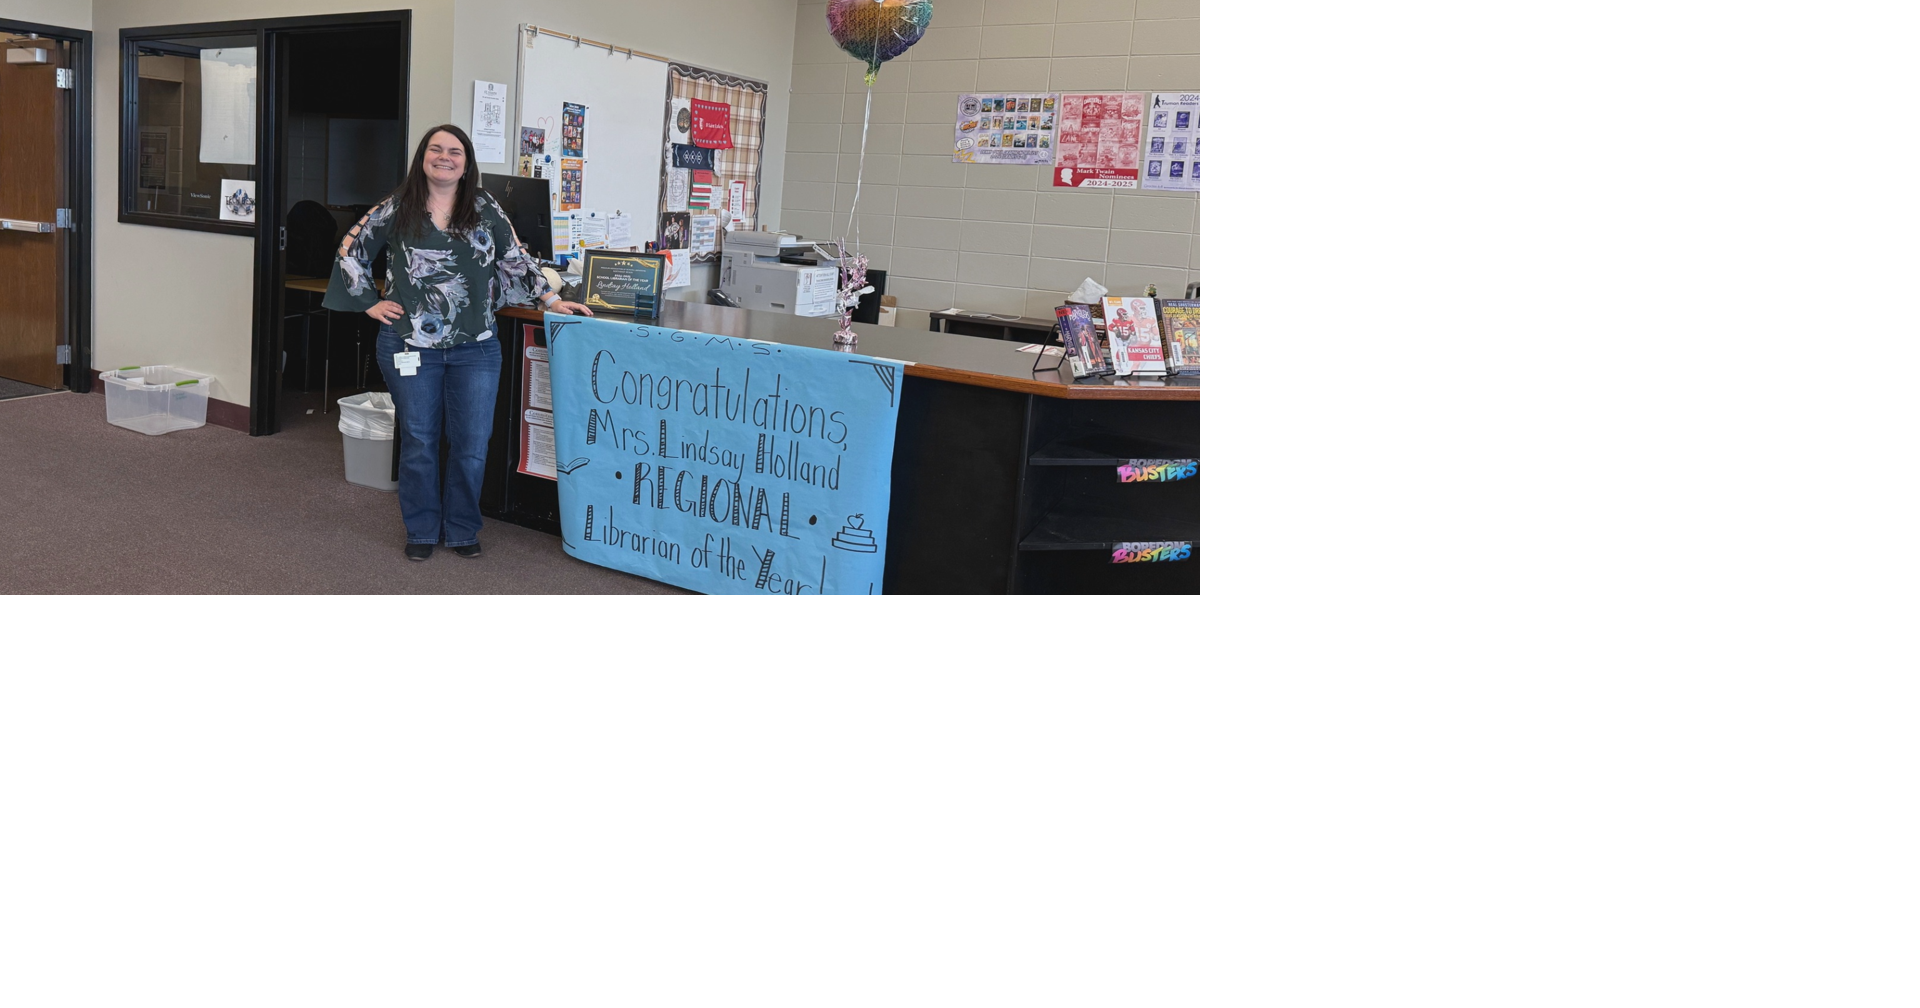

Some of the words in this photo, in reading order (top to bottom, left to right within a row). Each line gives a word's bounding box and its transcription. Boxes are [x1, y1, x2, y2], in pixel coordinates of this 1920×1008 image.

[591, 349, 849, 452] Congratulations,
[587, 408, 656, 457] Mrs.
[658, 418, 746, 485] Lindsay
[755, 433, 842, 491] Holland
[1117, 461, 1198, 483] BUSTERS
[632, 461, 801, 540] REGIONAL
[584, 504, 681, 565] Librarian
[690, 533, 714, 569] of
[715, 536, 747, 582] the
[1111, 543, 1192, 563] BUSTERS
